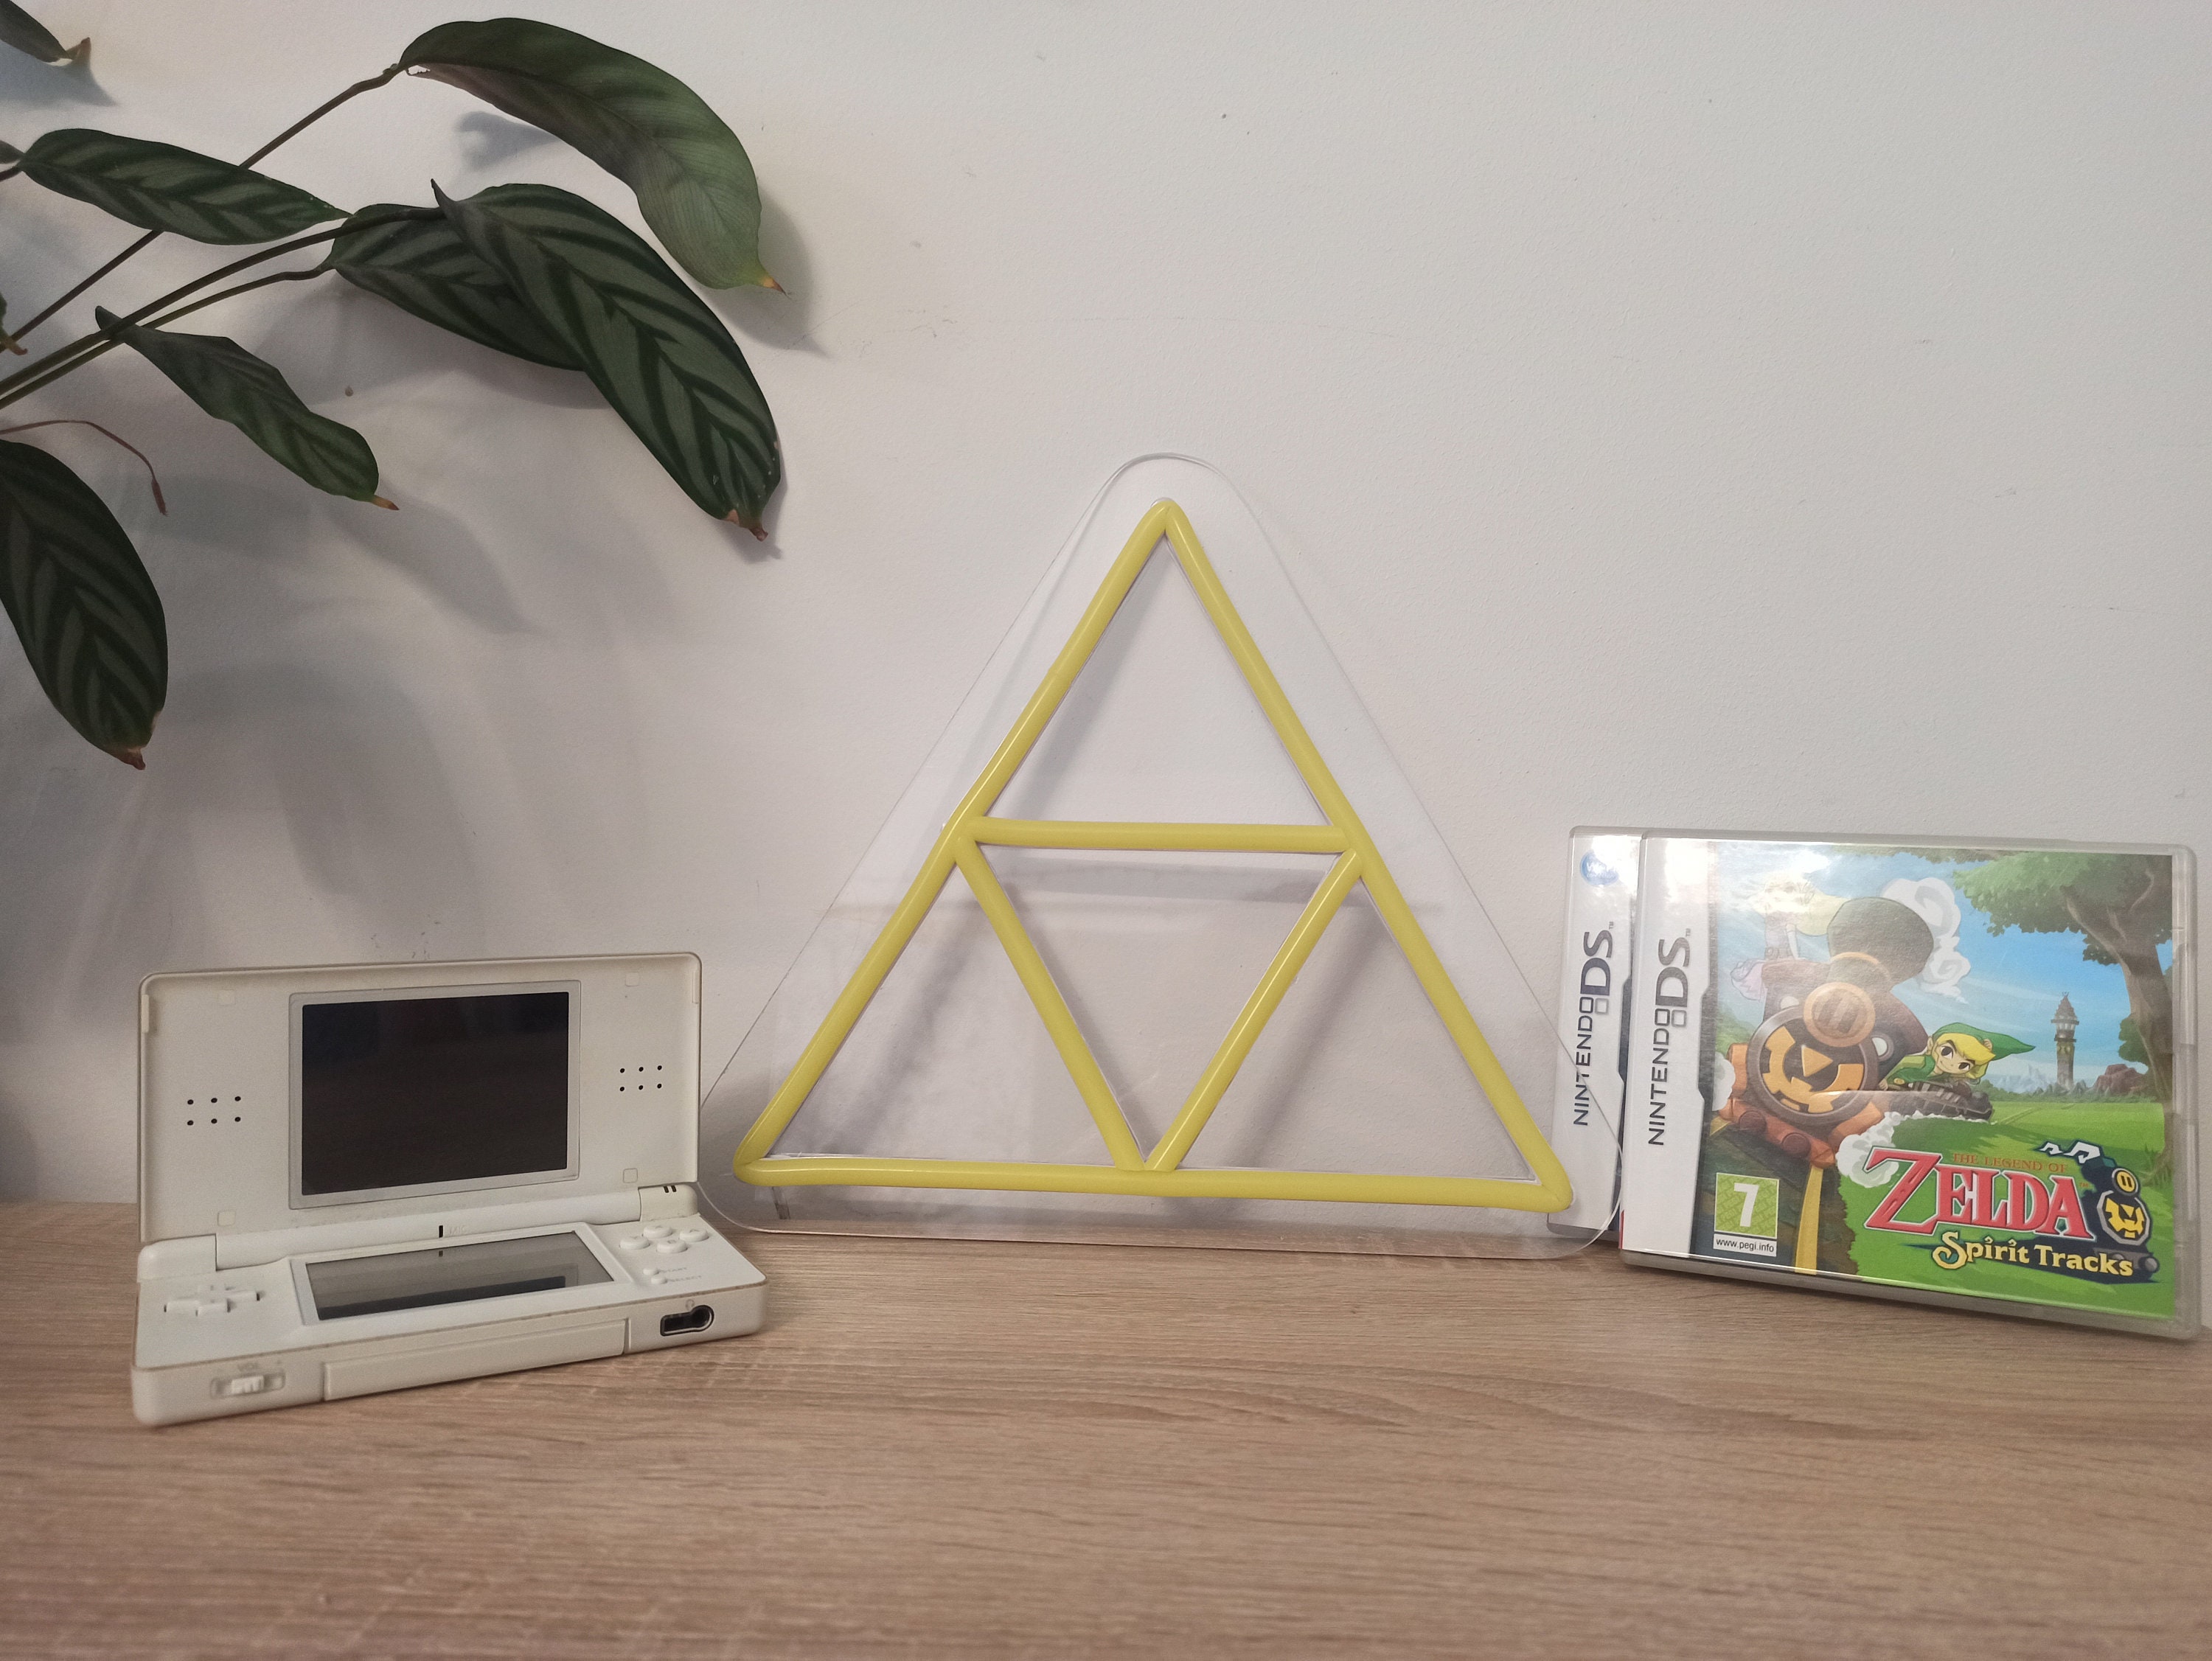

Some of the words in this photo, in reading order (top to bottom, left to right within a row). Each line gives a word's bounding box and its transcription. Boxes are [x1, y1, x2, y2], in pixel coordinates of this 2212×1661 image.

[1954, 1153, 1978, 1164] THE
[1984, 1157, 2042, 1171] LEGEND
[2048, 1163, 2067, 1173] OF
[1734, 1183, 1759, 1227] 7
[1864, 1145, 2096, 1242] ZELDA
[1716, 1239, 1774, 1252] www.pegi.info
[1933, 1231, 2030, 1270] Spirit
[2034, 1244, 2135, 1277] Tracks
